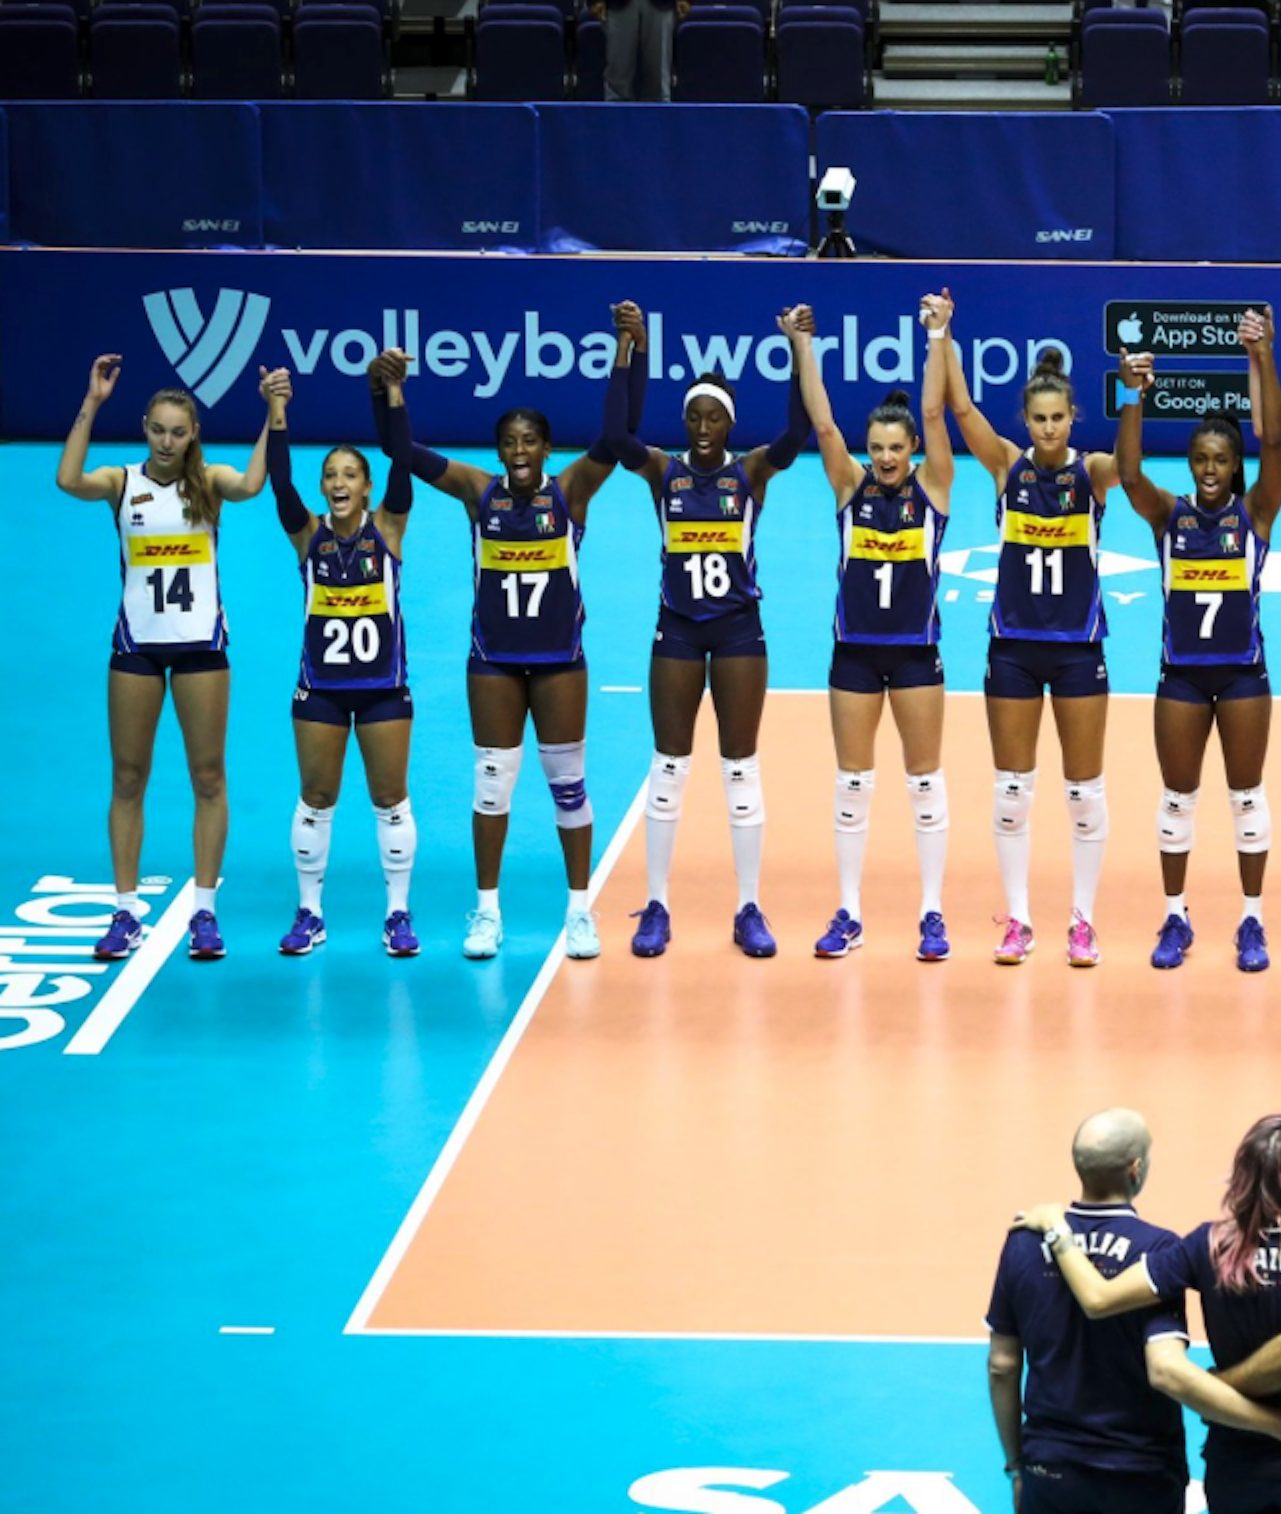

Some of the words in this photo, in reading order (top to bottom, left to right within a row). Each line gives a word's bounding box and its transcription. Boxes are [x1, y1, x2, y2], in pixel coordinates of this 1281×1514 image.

[1152, 311, 1211, 323] Download
[1214, 314, 1230, 323] on
[1152, 325, 1195, 349] App
[1155, 378, 1175, 389] GET
[1177, 378, 1187, 389] IT
[1188, 378, 1206, 389] ON
[1154, 391, 1220, 415] Google
[1224, 391, 1252, 410] Pla
[681, 531, 730, 543] DHL
[1023, 523, 1067, 538] DHL
[143, 544, 192, 557] DHL
[863, 539, 908, 552] DHL
[499, 550, 549, 562] DHL
[683, 553, 731, 600] 18
[1025, 547, 1064, 595] 11
[1183, 569, 1231, 581] DHL
[146, 567, 194, 613] 14
[501, 571, 550, 618] 17
[873, 562, 893, 609] 1
[325, 595, 373, 607] DHL
[1194, 592, 1224, 639] 7
[323, 617, 380, 664] 20
